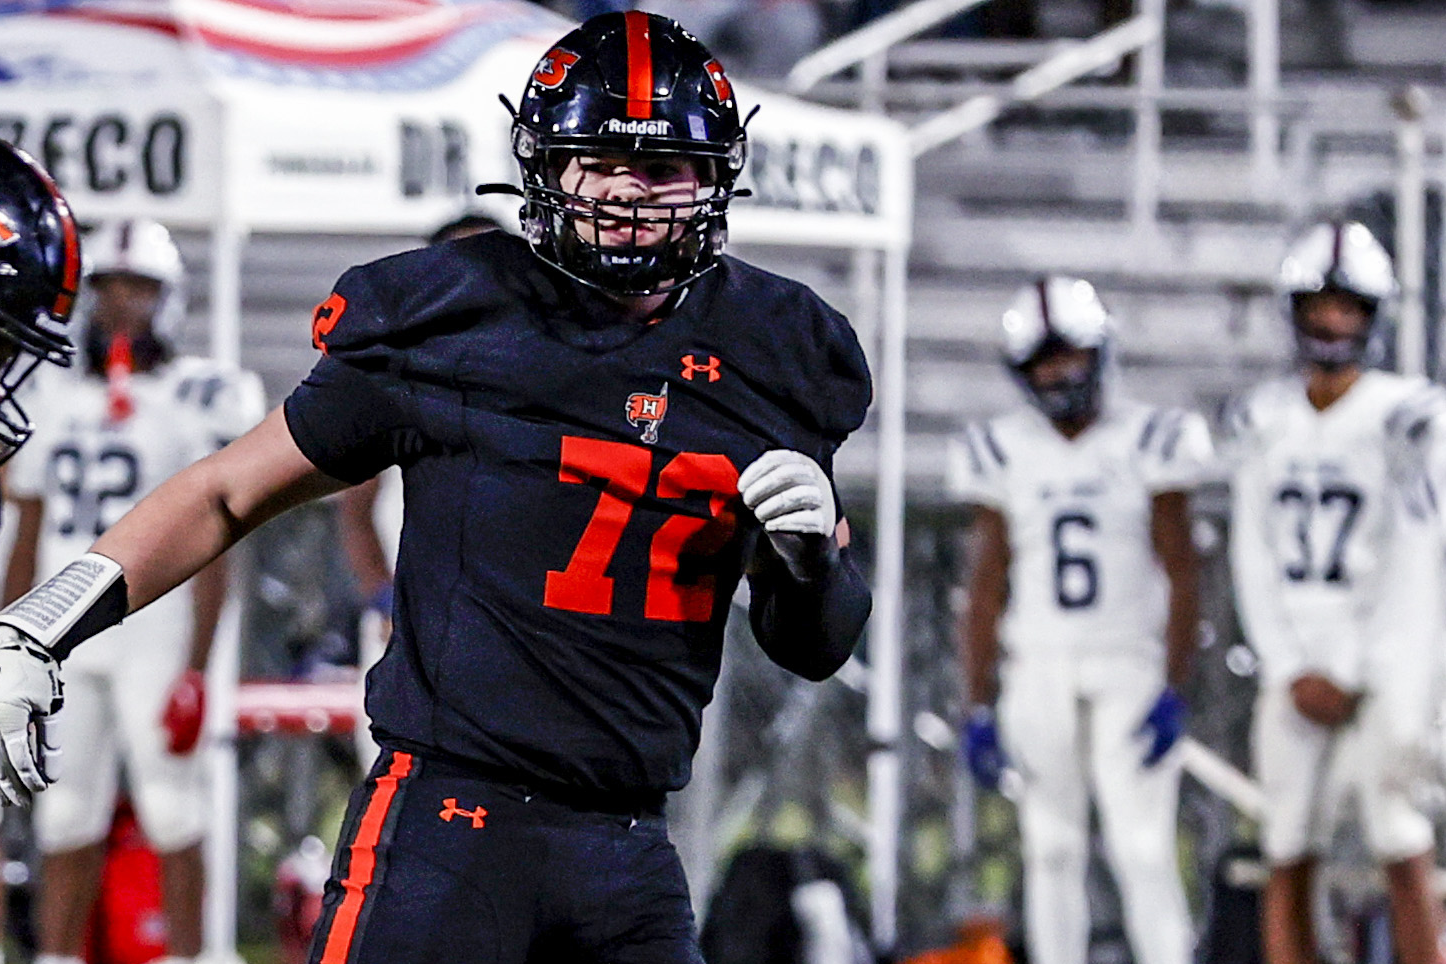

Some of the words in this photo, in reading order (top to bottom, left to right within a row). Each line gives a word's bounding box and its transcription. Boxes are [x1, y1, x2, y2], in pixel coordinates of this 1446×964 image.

[608, 118, 669, 136] Riddell
[641, 398, 658, 417] H
[543, 434, 741, 623] 72
[1055, 511, 1100, 610] 6
[1277, 482, 1362, 583] 37
